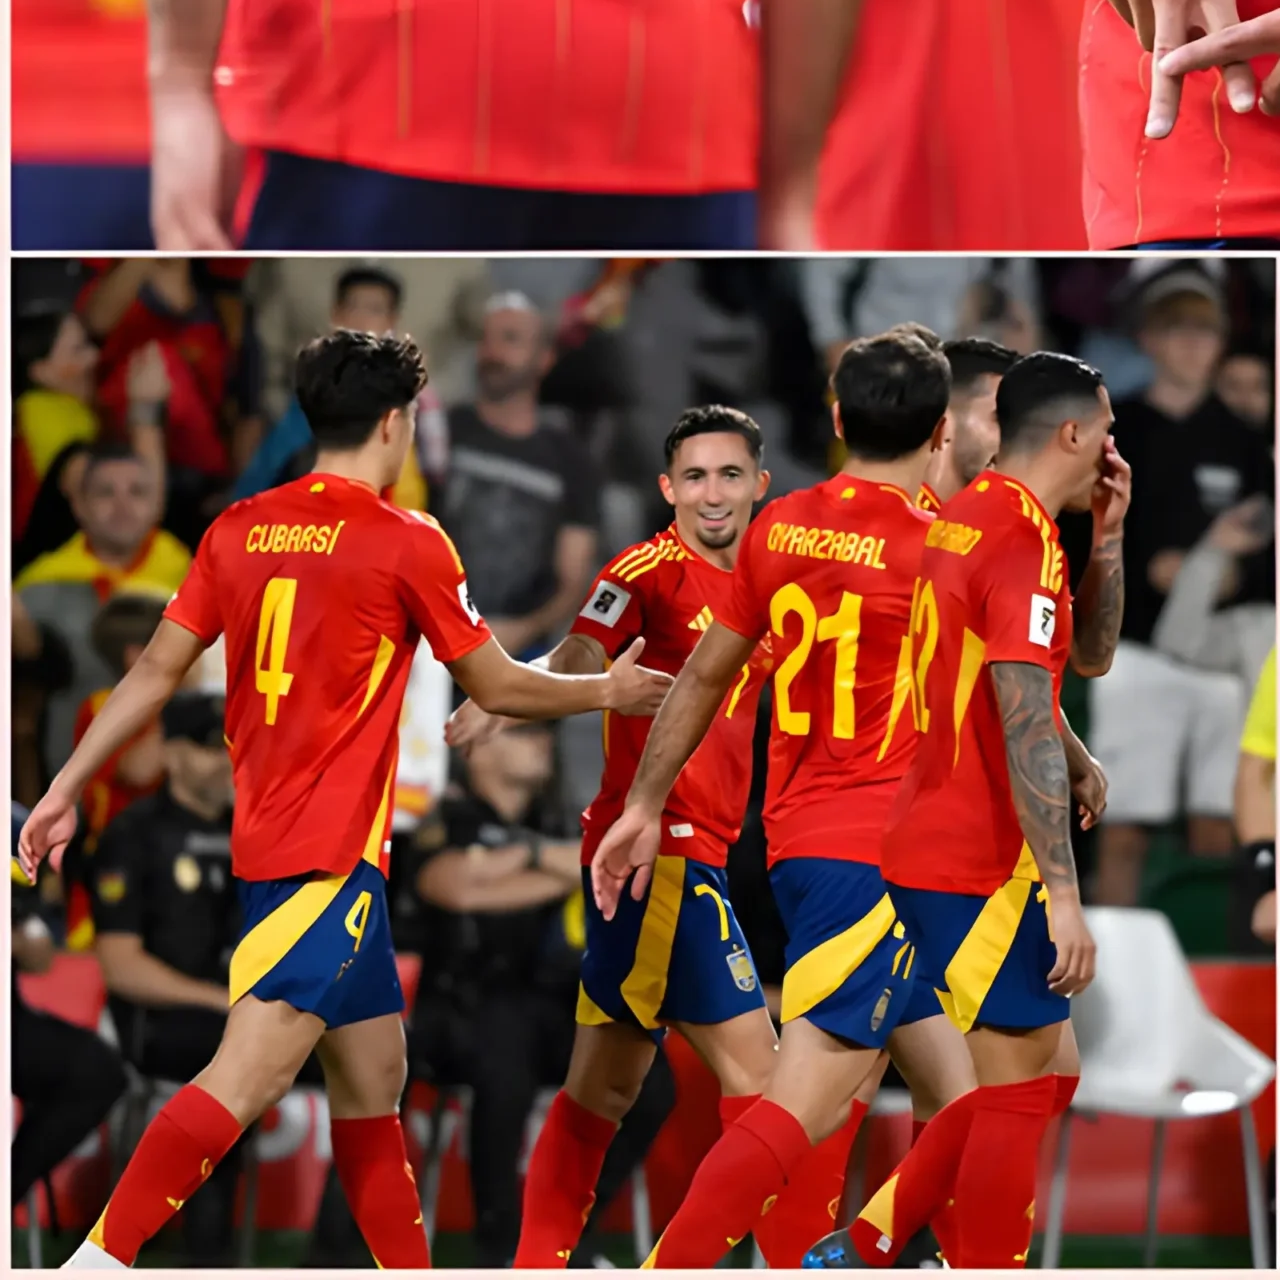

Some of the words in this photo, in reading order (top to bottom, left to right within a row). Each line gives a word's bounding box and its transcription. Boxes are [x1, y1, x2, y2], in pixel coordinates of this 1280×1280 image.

[767, 522, 887, 570] OYARZABAL
[256, 578, 298, 726] 4
[769, 582, 863, 740] 21
[694, 883, 730, 941] 7
